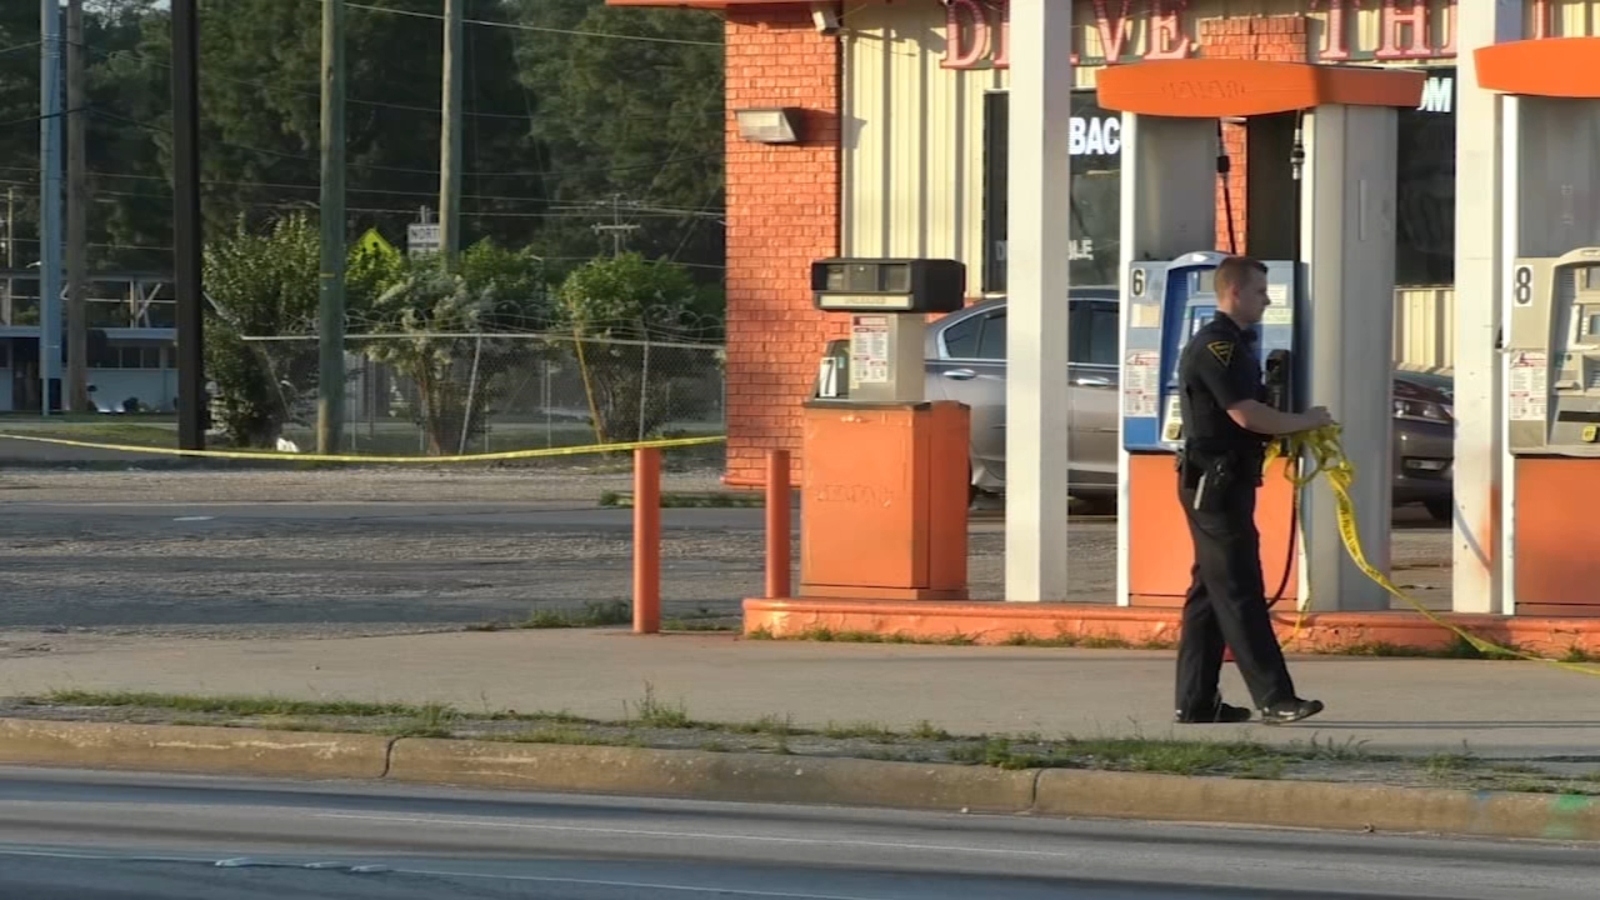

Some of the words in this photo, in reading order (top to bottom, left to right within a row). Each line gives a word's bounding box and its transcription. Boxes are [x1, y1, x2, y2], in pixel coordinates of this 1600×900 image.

[939, 0, 1188, 70] DVE
[410, 228, 441, 240] NORT
[1132, 269, 1144, 296] 6
[1516, 266, 1532, 305] 8
